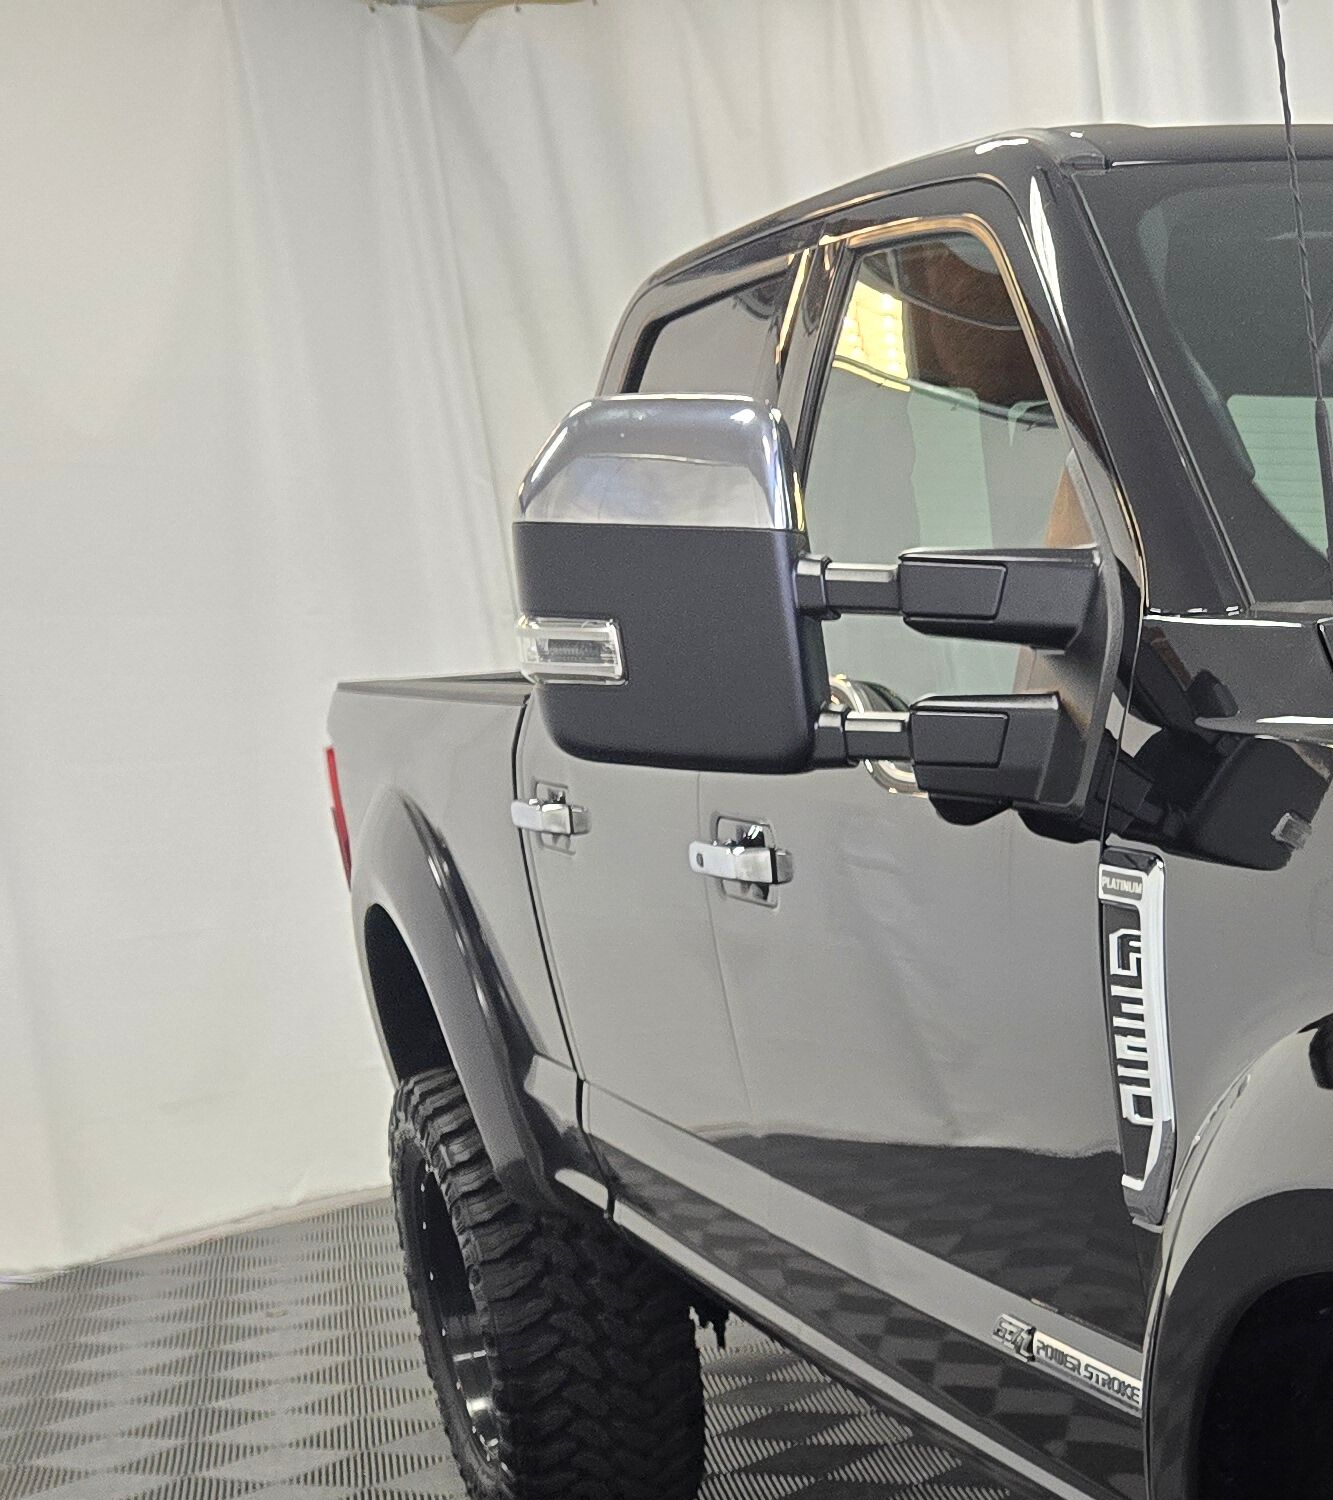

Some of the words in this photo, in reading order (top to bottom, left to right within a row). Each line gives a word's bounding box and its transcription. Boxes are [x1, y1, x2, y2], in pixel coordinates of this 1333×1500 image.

[1101, 875, 1142, 894] PLATINUM
[1036, 1338, 1082, 1376] POWER
[1083, 1363, 1141, 1405] STROKE
